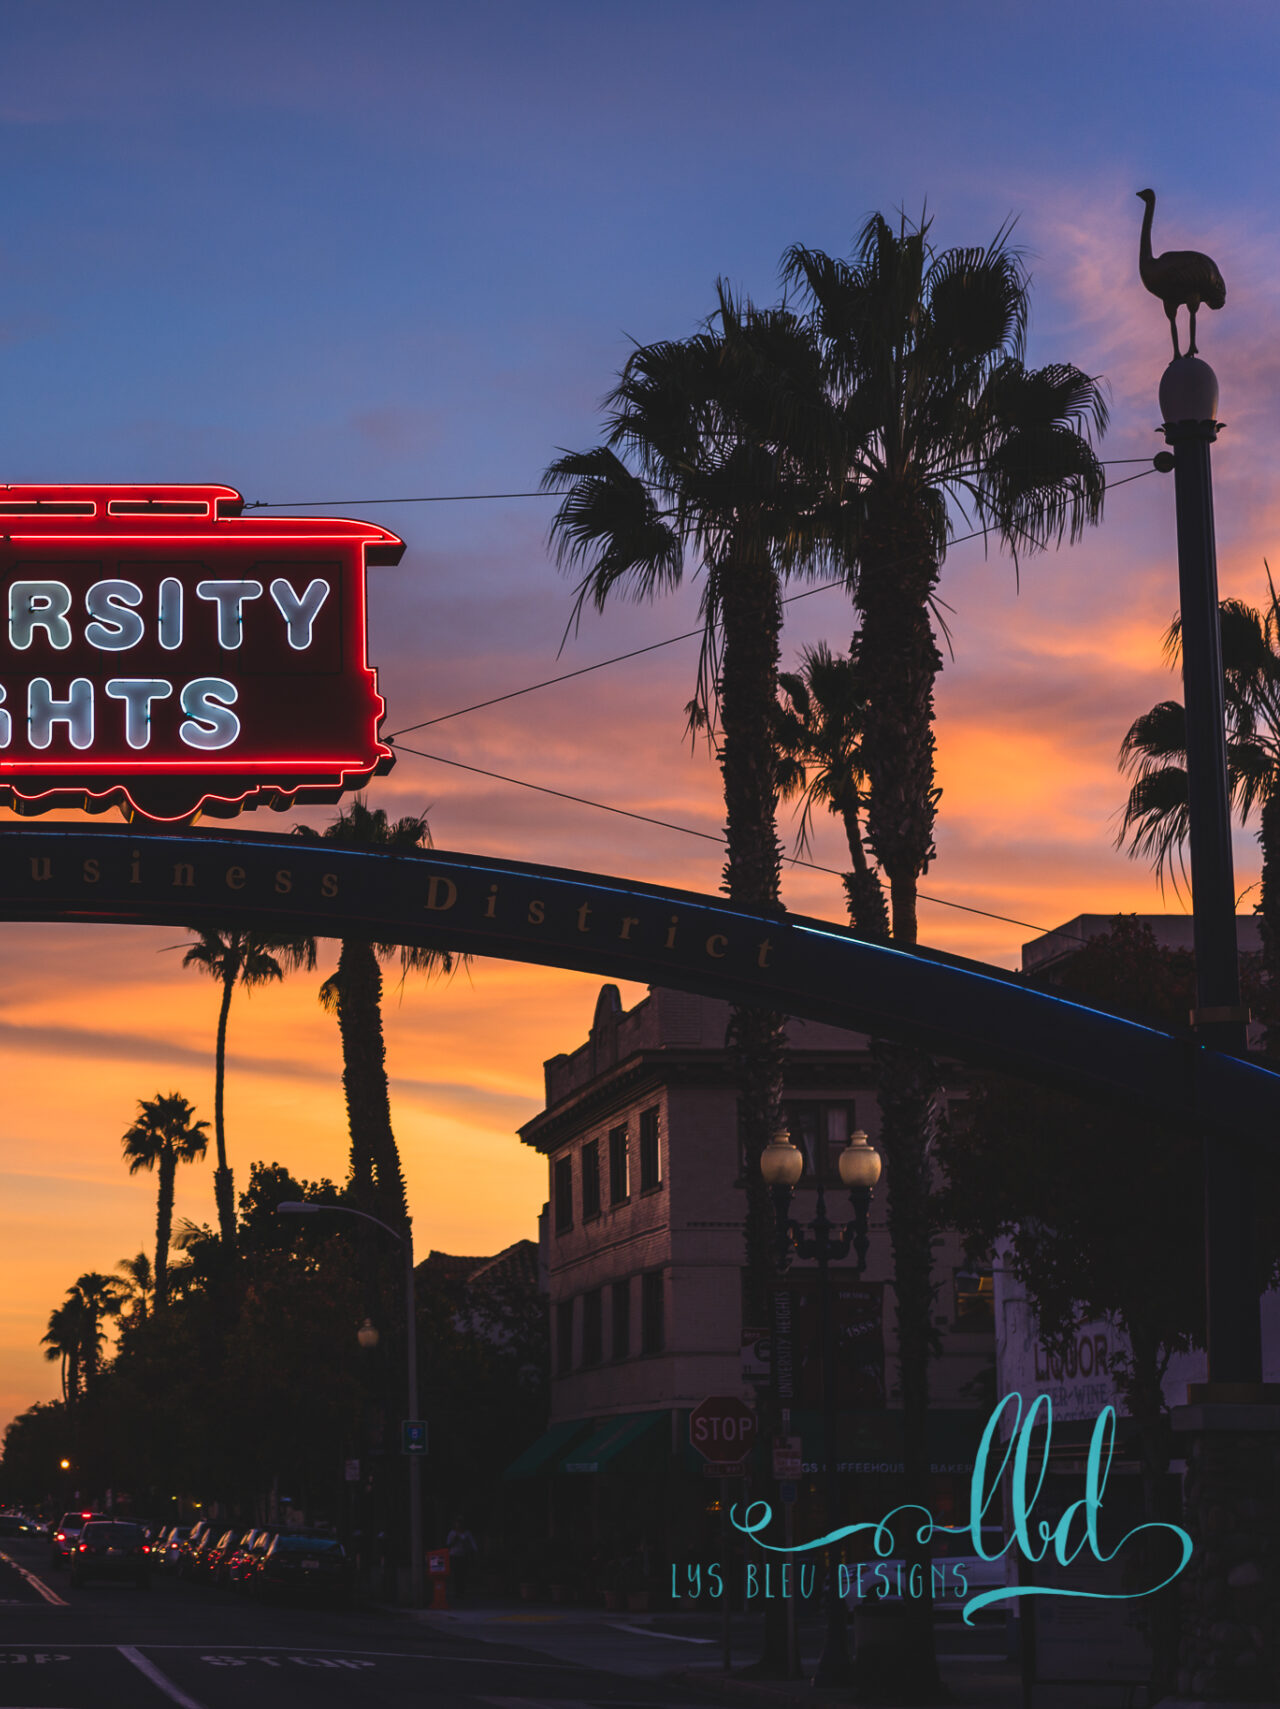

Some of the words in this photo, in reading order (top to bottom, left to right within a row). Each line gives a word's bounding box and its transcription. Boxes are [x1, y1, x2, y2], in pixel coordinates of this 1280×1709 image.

[423, 875, 774, 968] District
[1034, 1335, 1109, 1384] LIQUOR
[695, 1417, 753, 1441] STOP
[930, 1464, 974, 1474] BAKER
[199, 1655, 377, 1670] STOP
